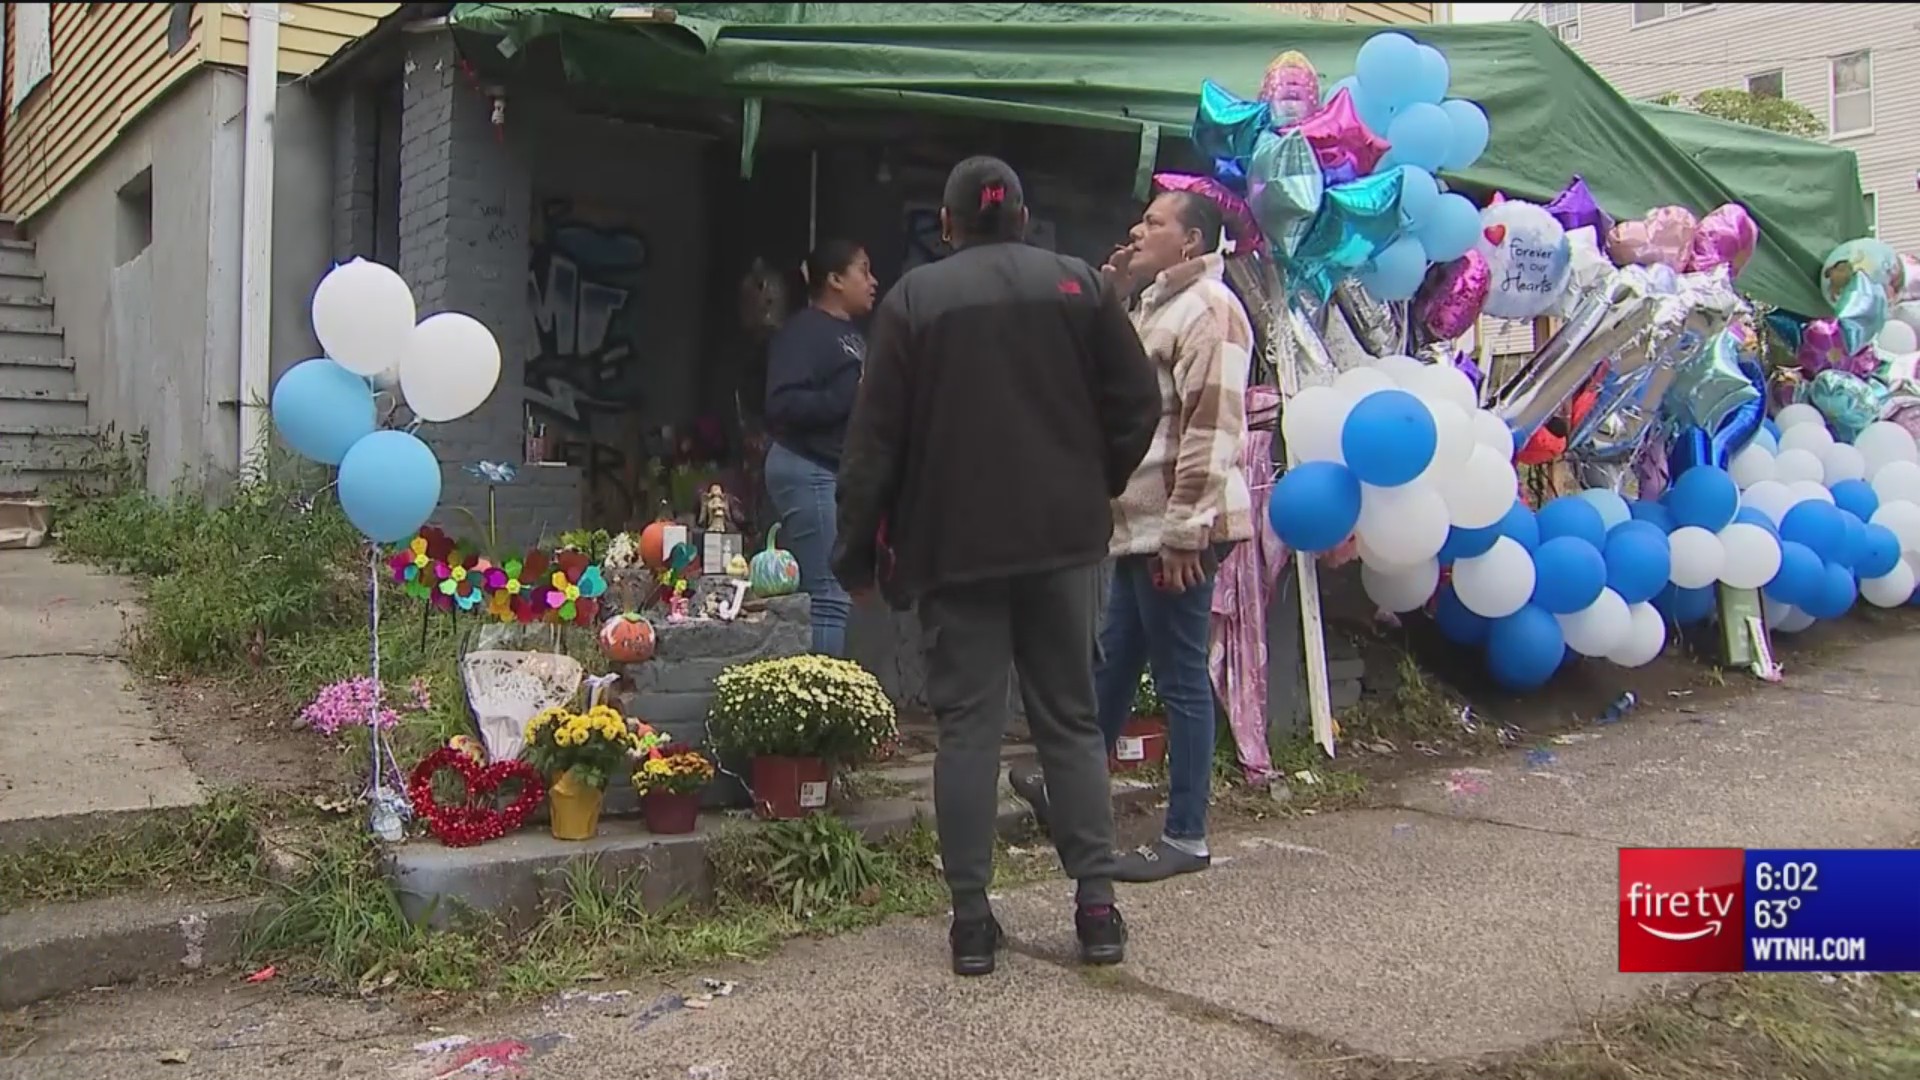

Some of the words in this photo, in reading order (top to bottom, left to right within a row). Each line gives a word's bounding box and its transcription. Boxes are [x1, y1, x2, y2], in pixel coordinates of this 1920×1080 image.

[1510, 237, 1553, 260] Forever
[1530, 263, 1548, 273] our
[1501, 269, 1553, 294] Hearts
